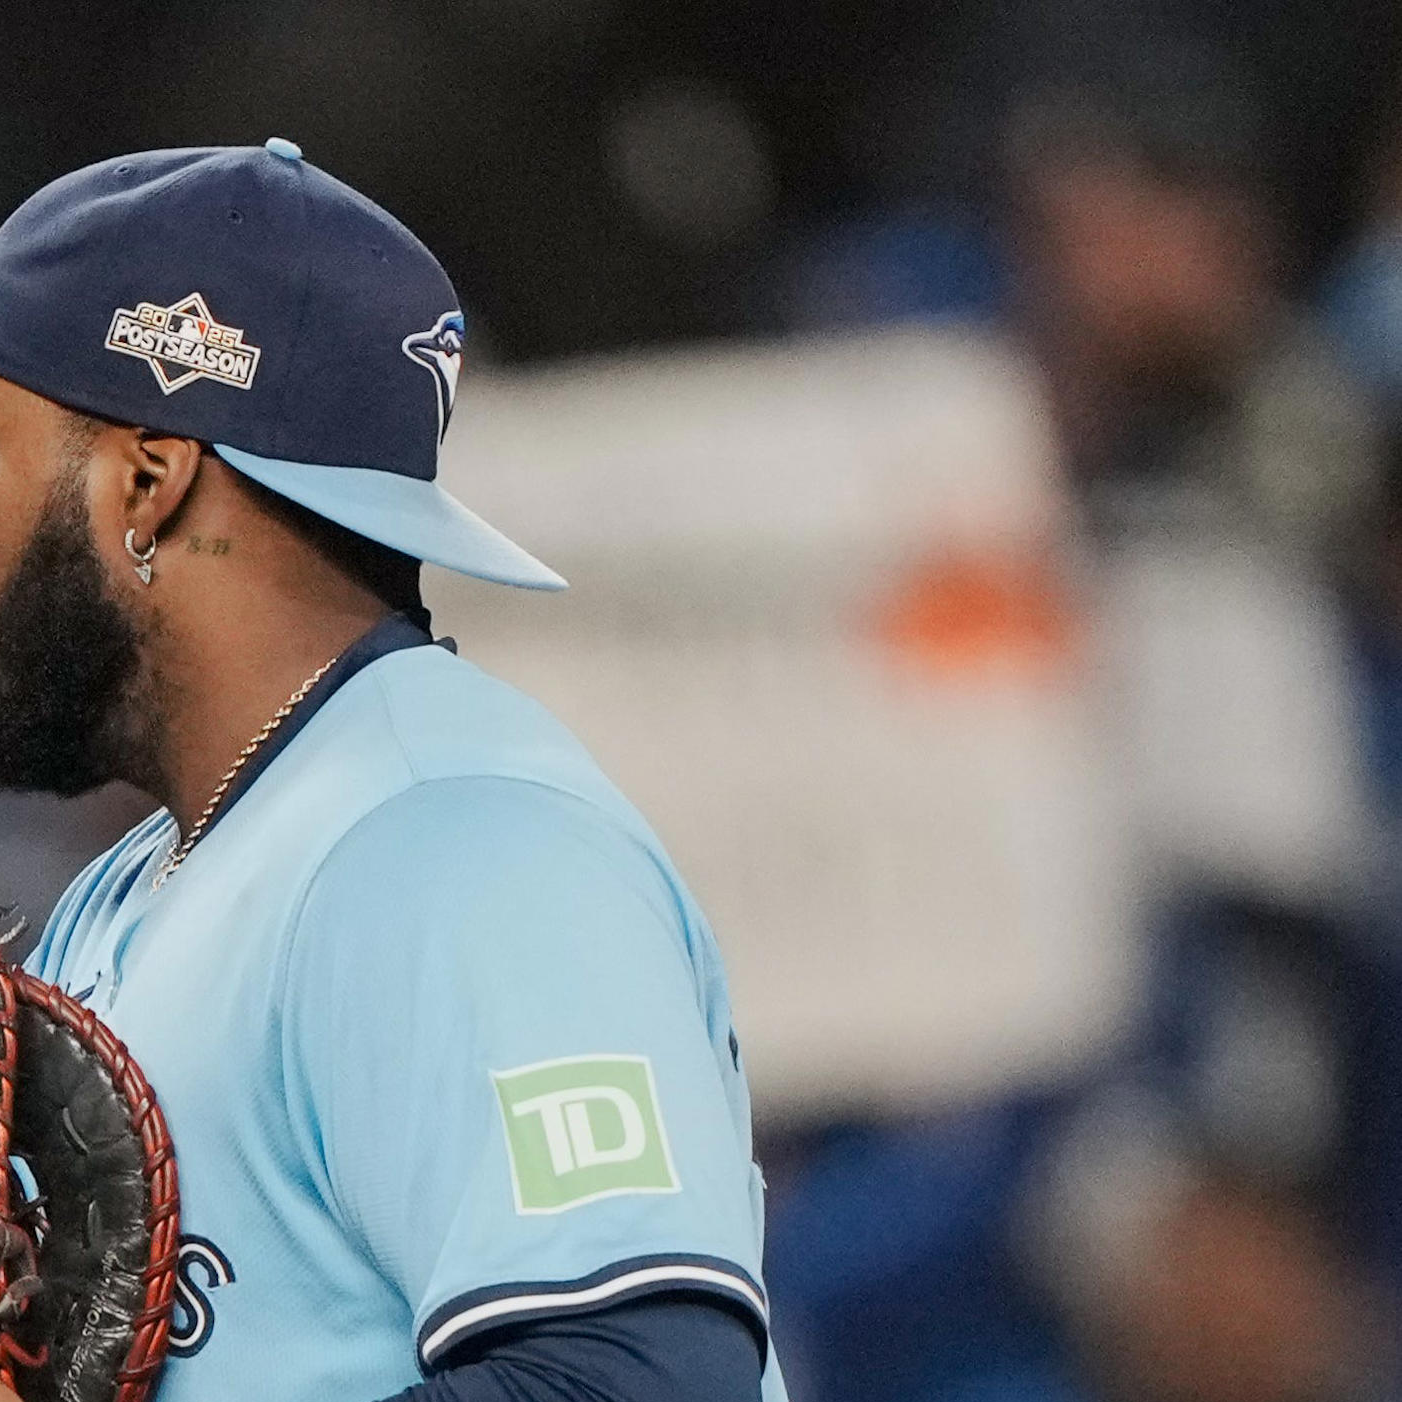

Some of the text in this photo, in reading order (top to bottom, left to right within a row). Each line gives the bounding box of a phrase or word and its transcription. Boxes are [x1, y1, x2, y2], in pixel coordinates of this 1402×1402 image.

[113, 318, 251, 379] POSTSEASON
[138, 307, 237, 346] 20 25
[511, 1085, 646, 1176] TD
